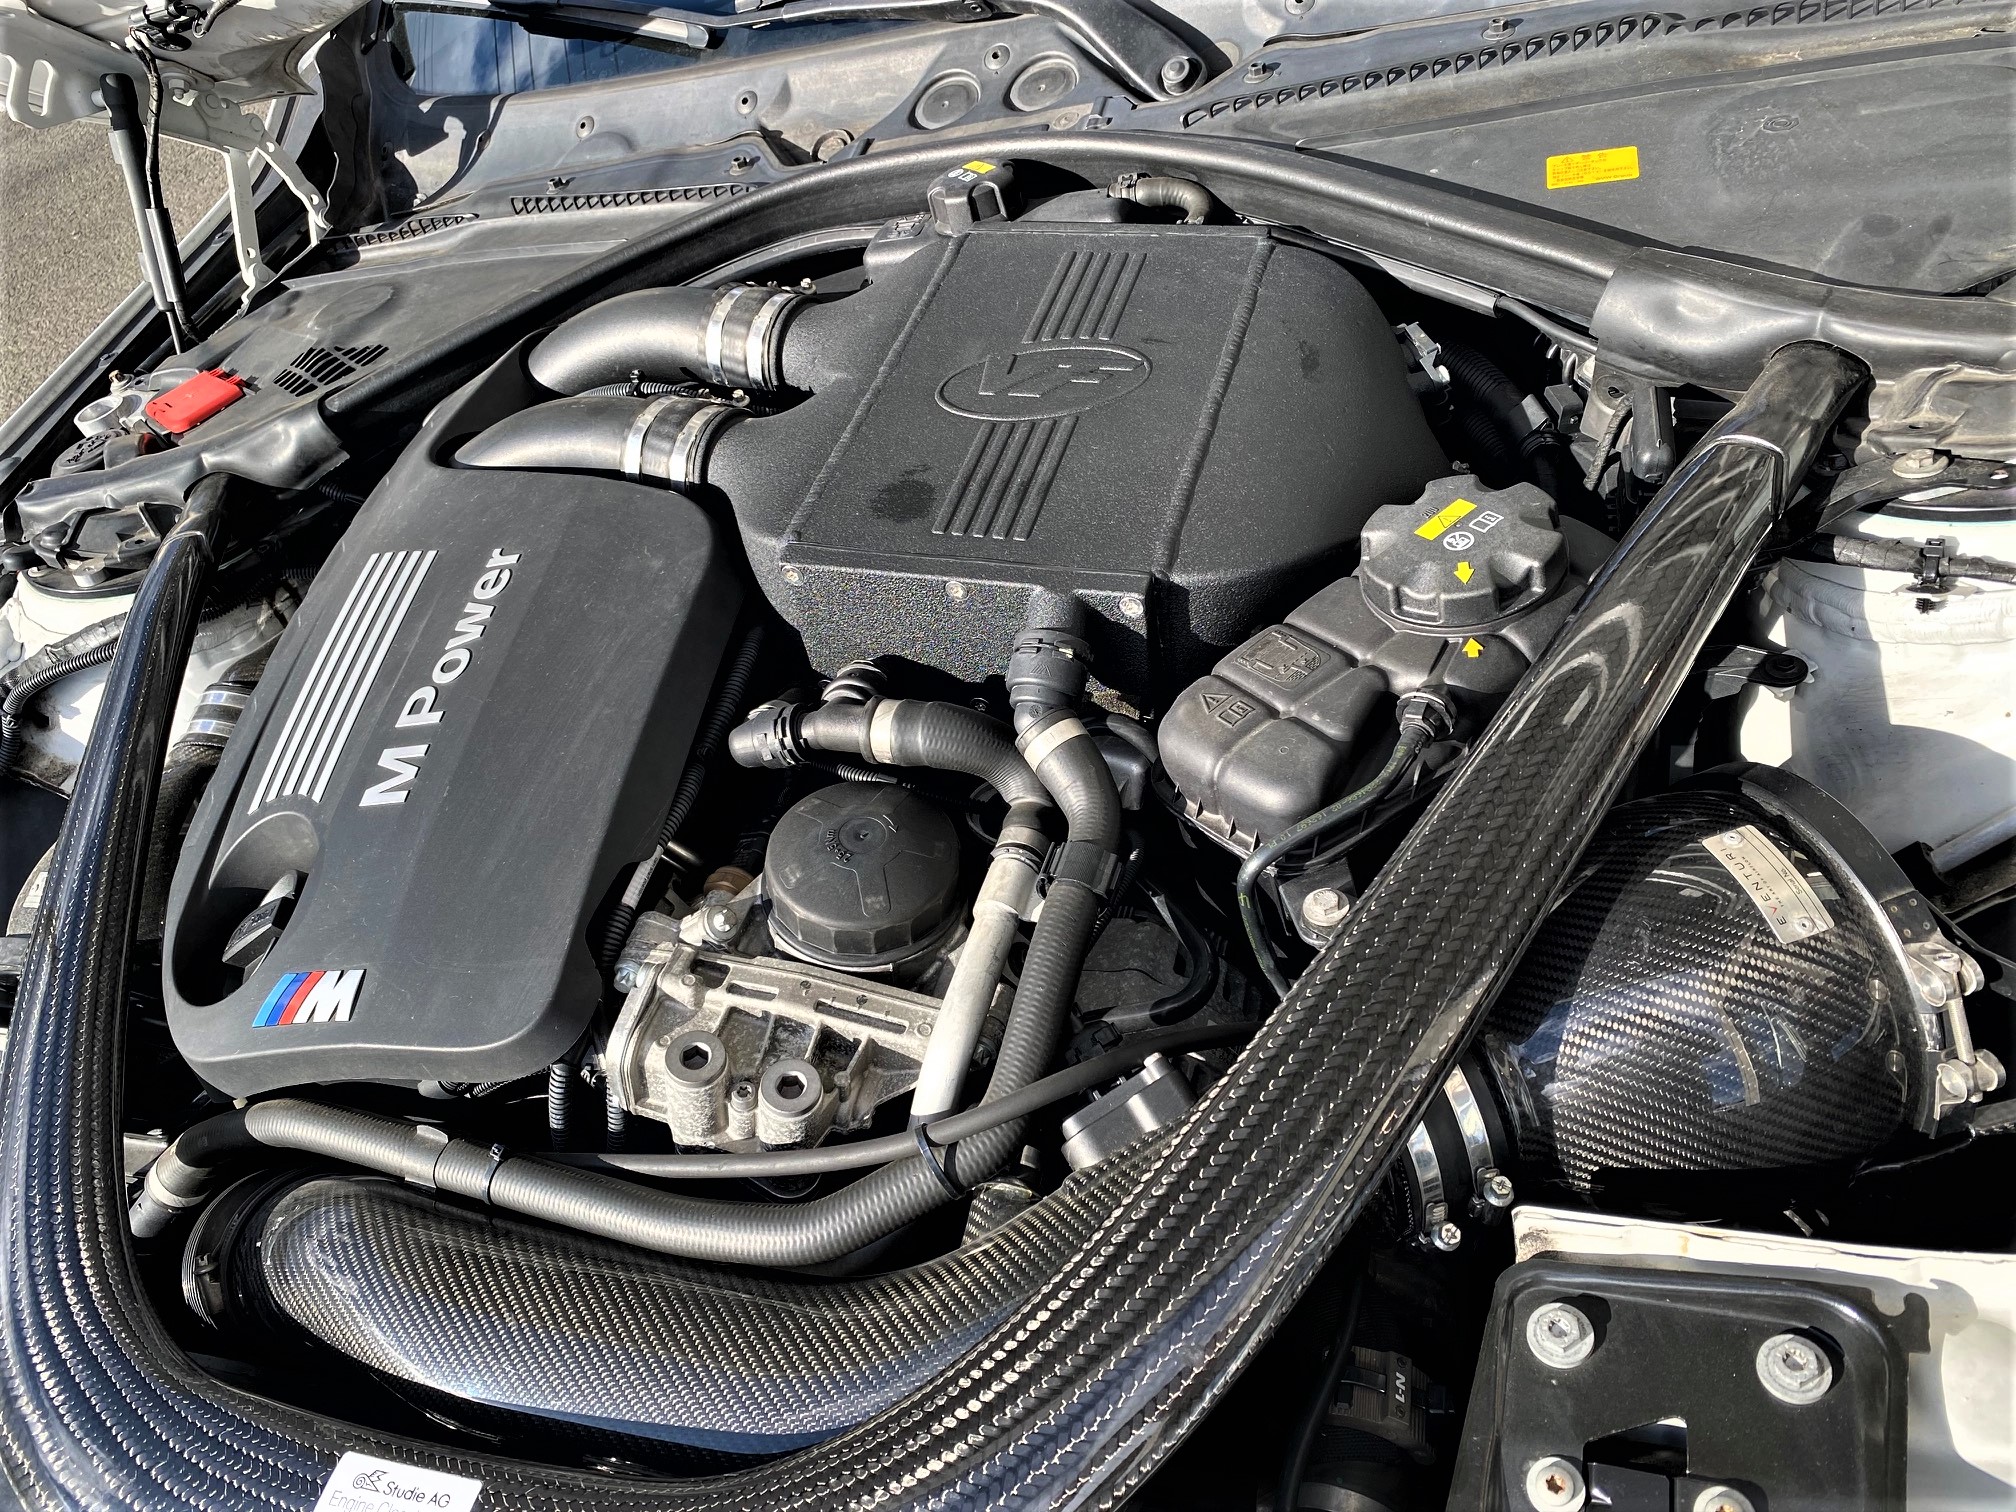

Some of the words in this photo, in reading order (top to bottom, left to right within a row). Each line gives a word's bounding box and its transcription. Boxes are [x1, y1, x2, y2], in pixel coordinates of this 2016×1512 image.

[359, 743, 431, 807] M
[395, 548, 522, 728] Power
[1720, 847, 1788, 926] EVENTURI
[383, 1481, 426, 1503] Studie
[427, 1493, 451, 1508] AG
